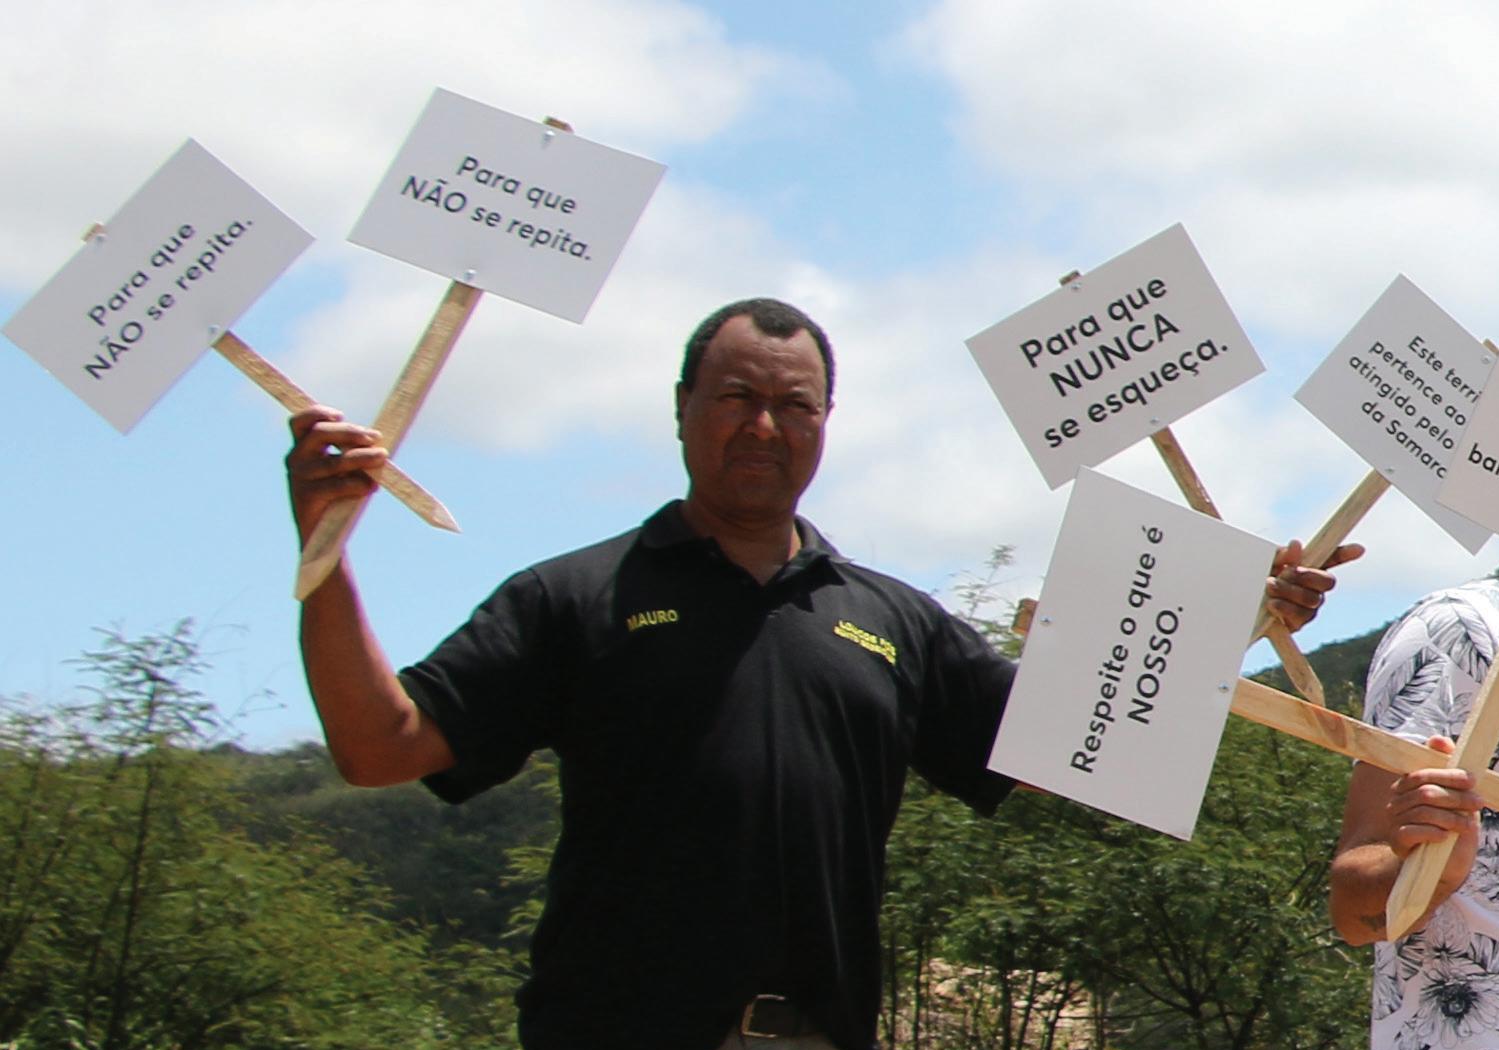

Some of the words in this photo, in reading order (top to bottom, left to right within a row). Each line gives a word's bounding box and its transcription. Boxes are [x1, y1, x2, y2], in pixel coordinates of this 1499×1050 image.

[402, 176, 467, 213] NÃO
[471, 207, 501, 227] se
[507, 220, 590, 260] repita.
[457, 157, 521, 194] Para
[527, 187, 576, 213] que
[84, 322, 143, 379] NÃO
[147, 293, 175, 321] se
[176, 221, 252, 290] repita.
[88, 271, 149, 326] Para
[151, 223, 195, 268] que
[1020, 315, 1101, 368] Para
[1108, 280, 1166, 322] que
[1050, 314, 1179, 397] NUNCA
[1045, 419, 1080, 448] se
[1088, 340, 1227, 422] esqueça.
[1350, 357, 1416, 416] atingido
[1415, 416, 1454, 449] pelo
[1369, 342, 1442, 405] pertence
[1445, 406, 1466, 425] ao
[1408, 336, 1443, 371] Este
[1445, 369, 1482, 403] terri
[1362, 402, 1385, 423] da
[1386, 420, 1446, 478] Samarc
[626, 609, 678, 631] MAURO
[1071, 645, 1128, 773] Respeite
[1120, 618, 1136, 635] o
[1128, 554, 1155, 608] que
[1142, 526, 1163, 544] é
[1127, 607, 1183, 724] NOSSO.
